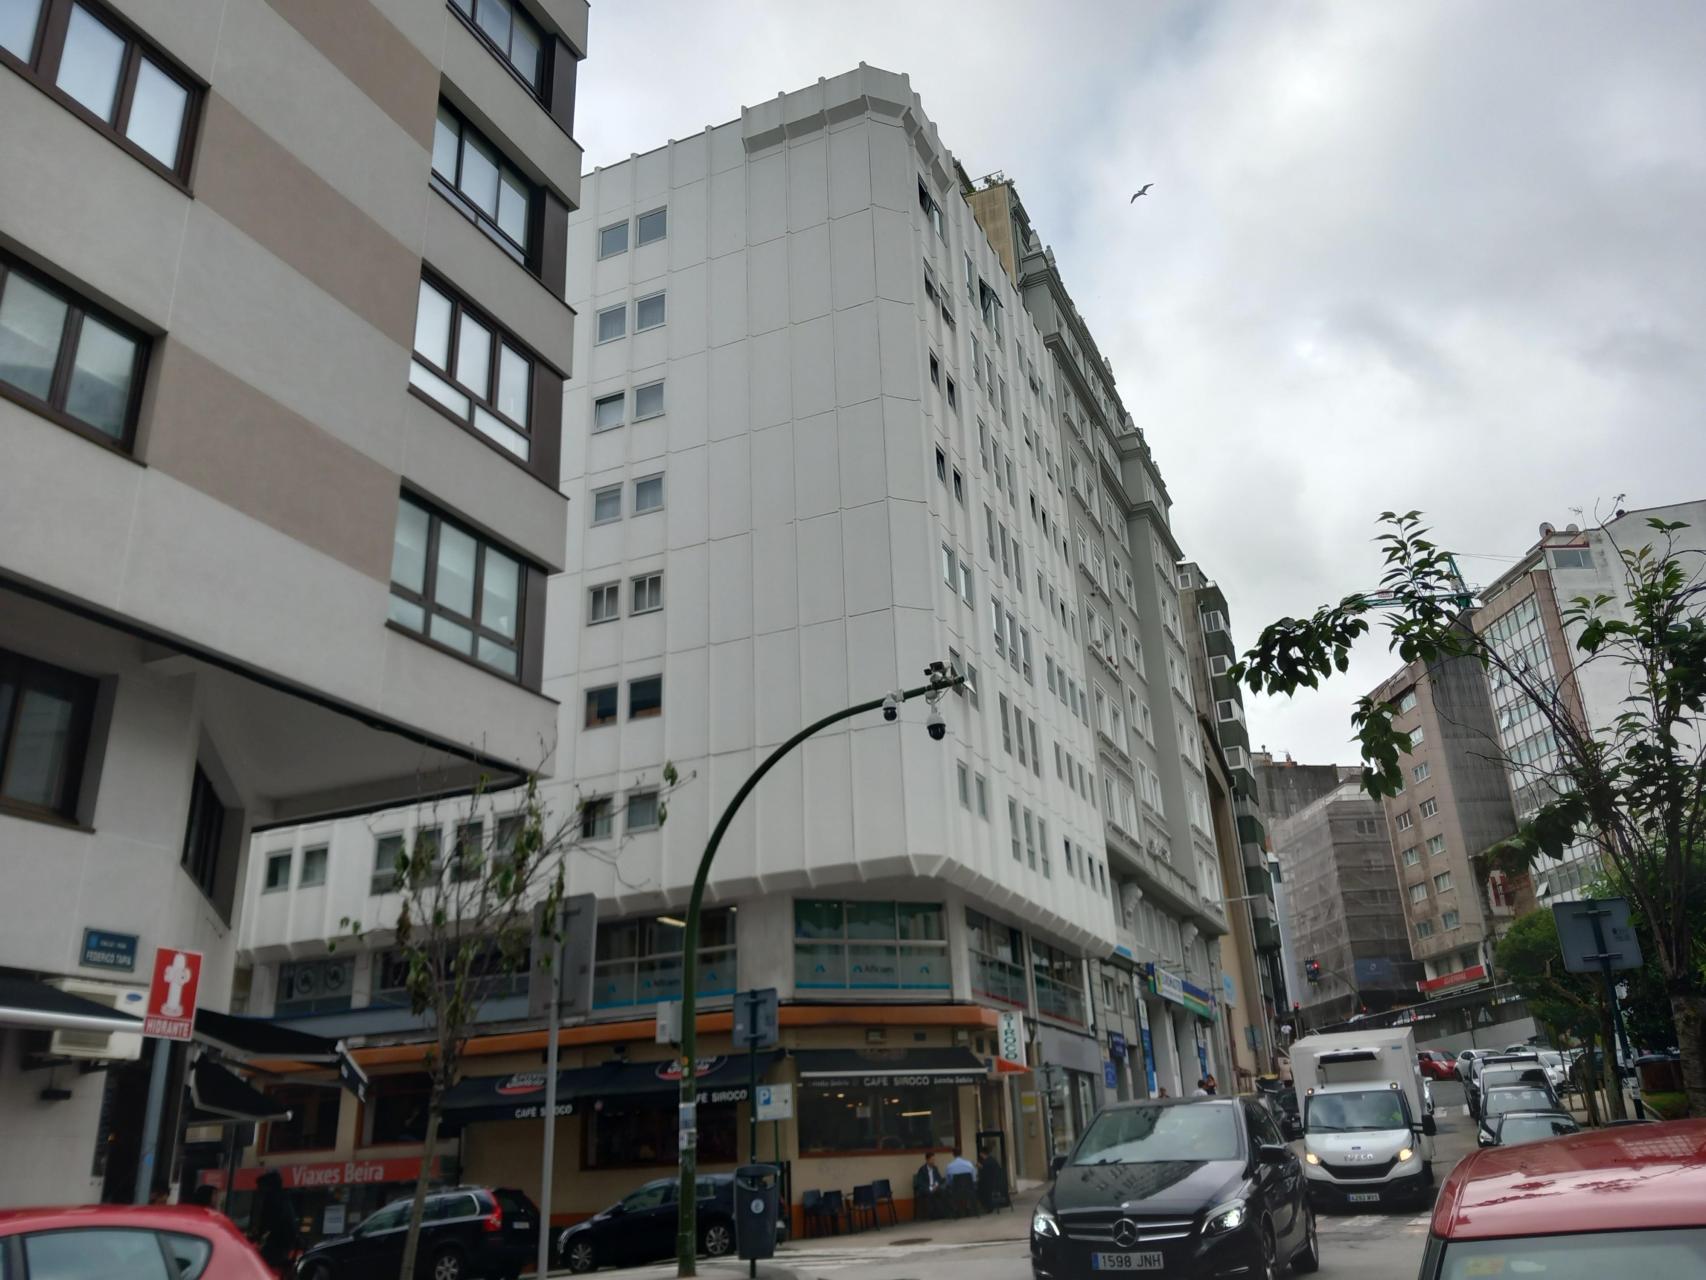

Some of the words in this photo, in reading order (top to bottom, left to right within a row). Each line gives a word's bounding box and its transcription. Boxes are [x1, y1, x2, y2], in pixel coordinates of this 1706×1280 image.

[145, 1019, 191, 1038] HIDRANTE
[1003, 1013, 1018, 1060] SIROCO
[893, 1075, 930, 1087] SIROCO
[711, 1089, 748, 1103] SIROCO
[292, 1165, 340, 1186] Viaxes
[343, 1162, 384, 1184] Beira
[1102, 1254, 1132, 1268] 1598
[1136, 1253, 1161, 1268] JNH
